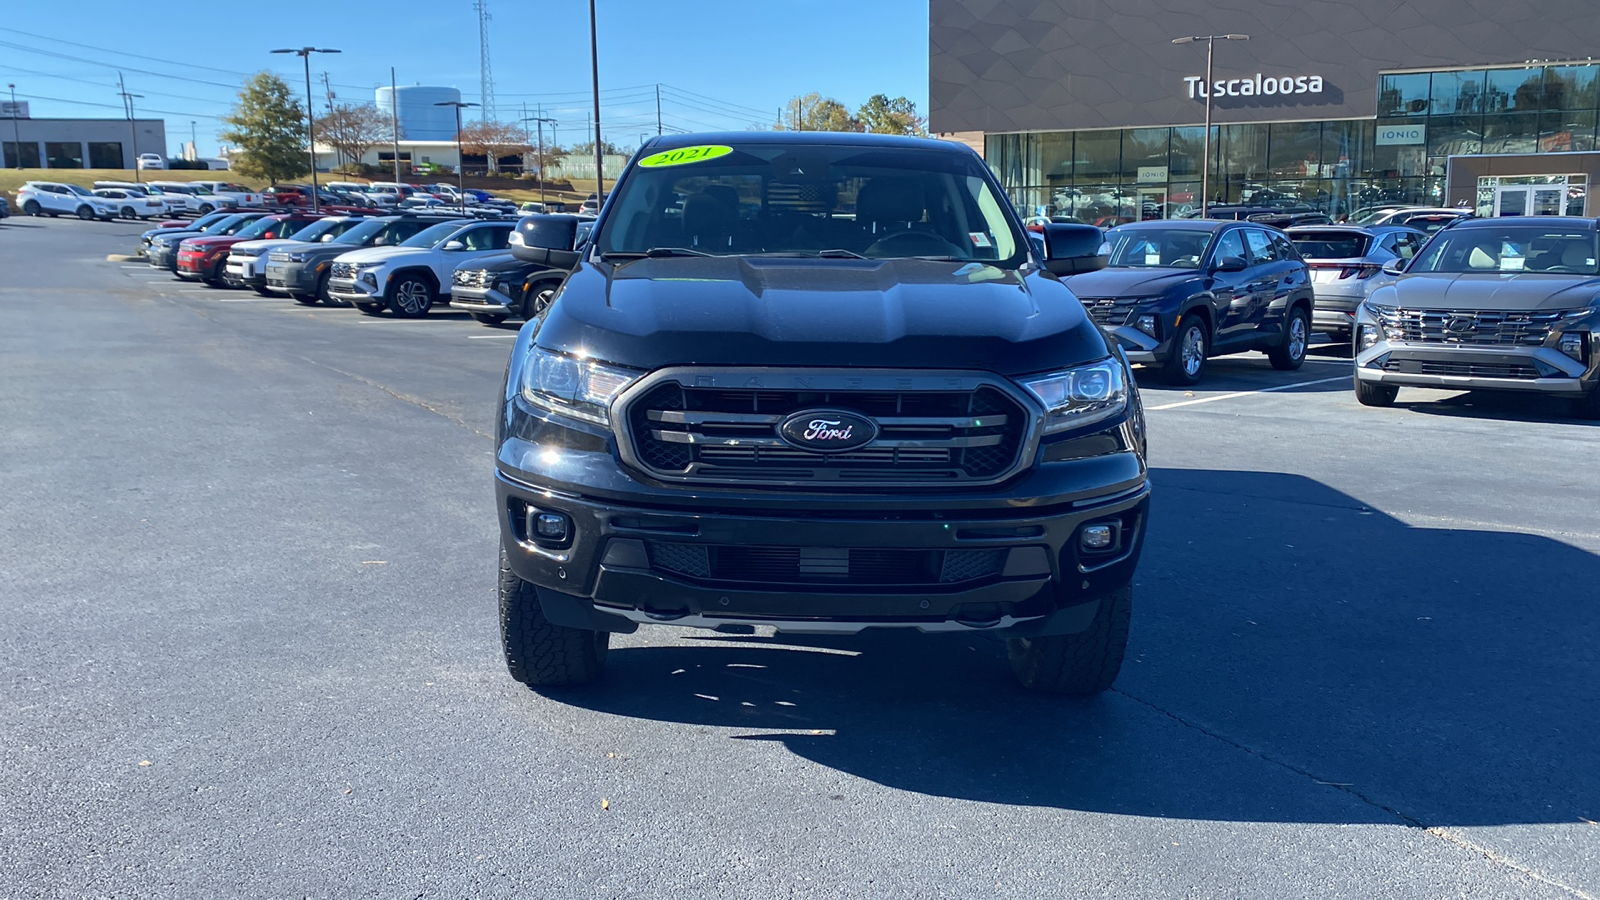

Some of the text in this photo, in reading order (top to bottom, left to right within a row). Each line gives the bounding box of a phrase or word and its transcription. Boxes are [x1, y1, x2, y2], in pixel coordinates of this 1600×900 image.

[1183, 73, 1323, 99] Tuscaloosa
[654, 147, 713, 165] 2021
[803, 419, 853, 440] Ford
